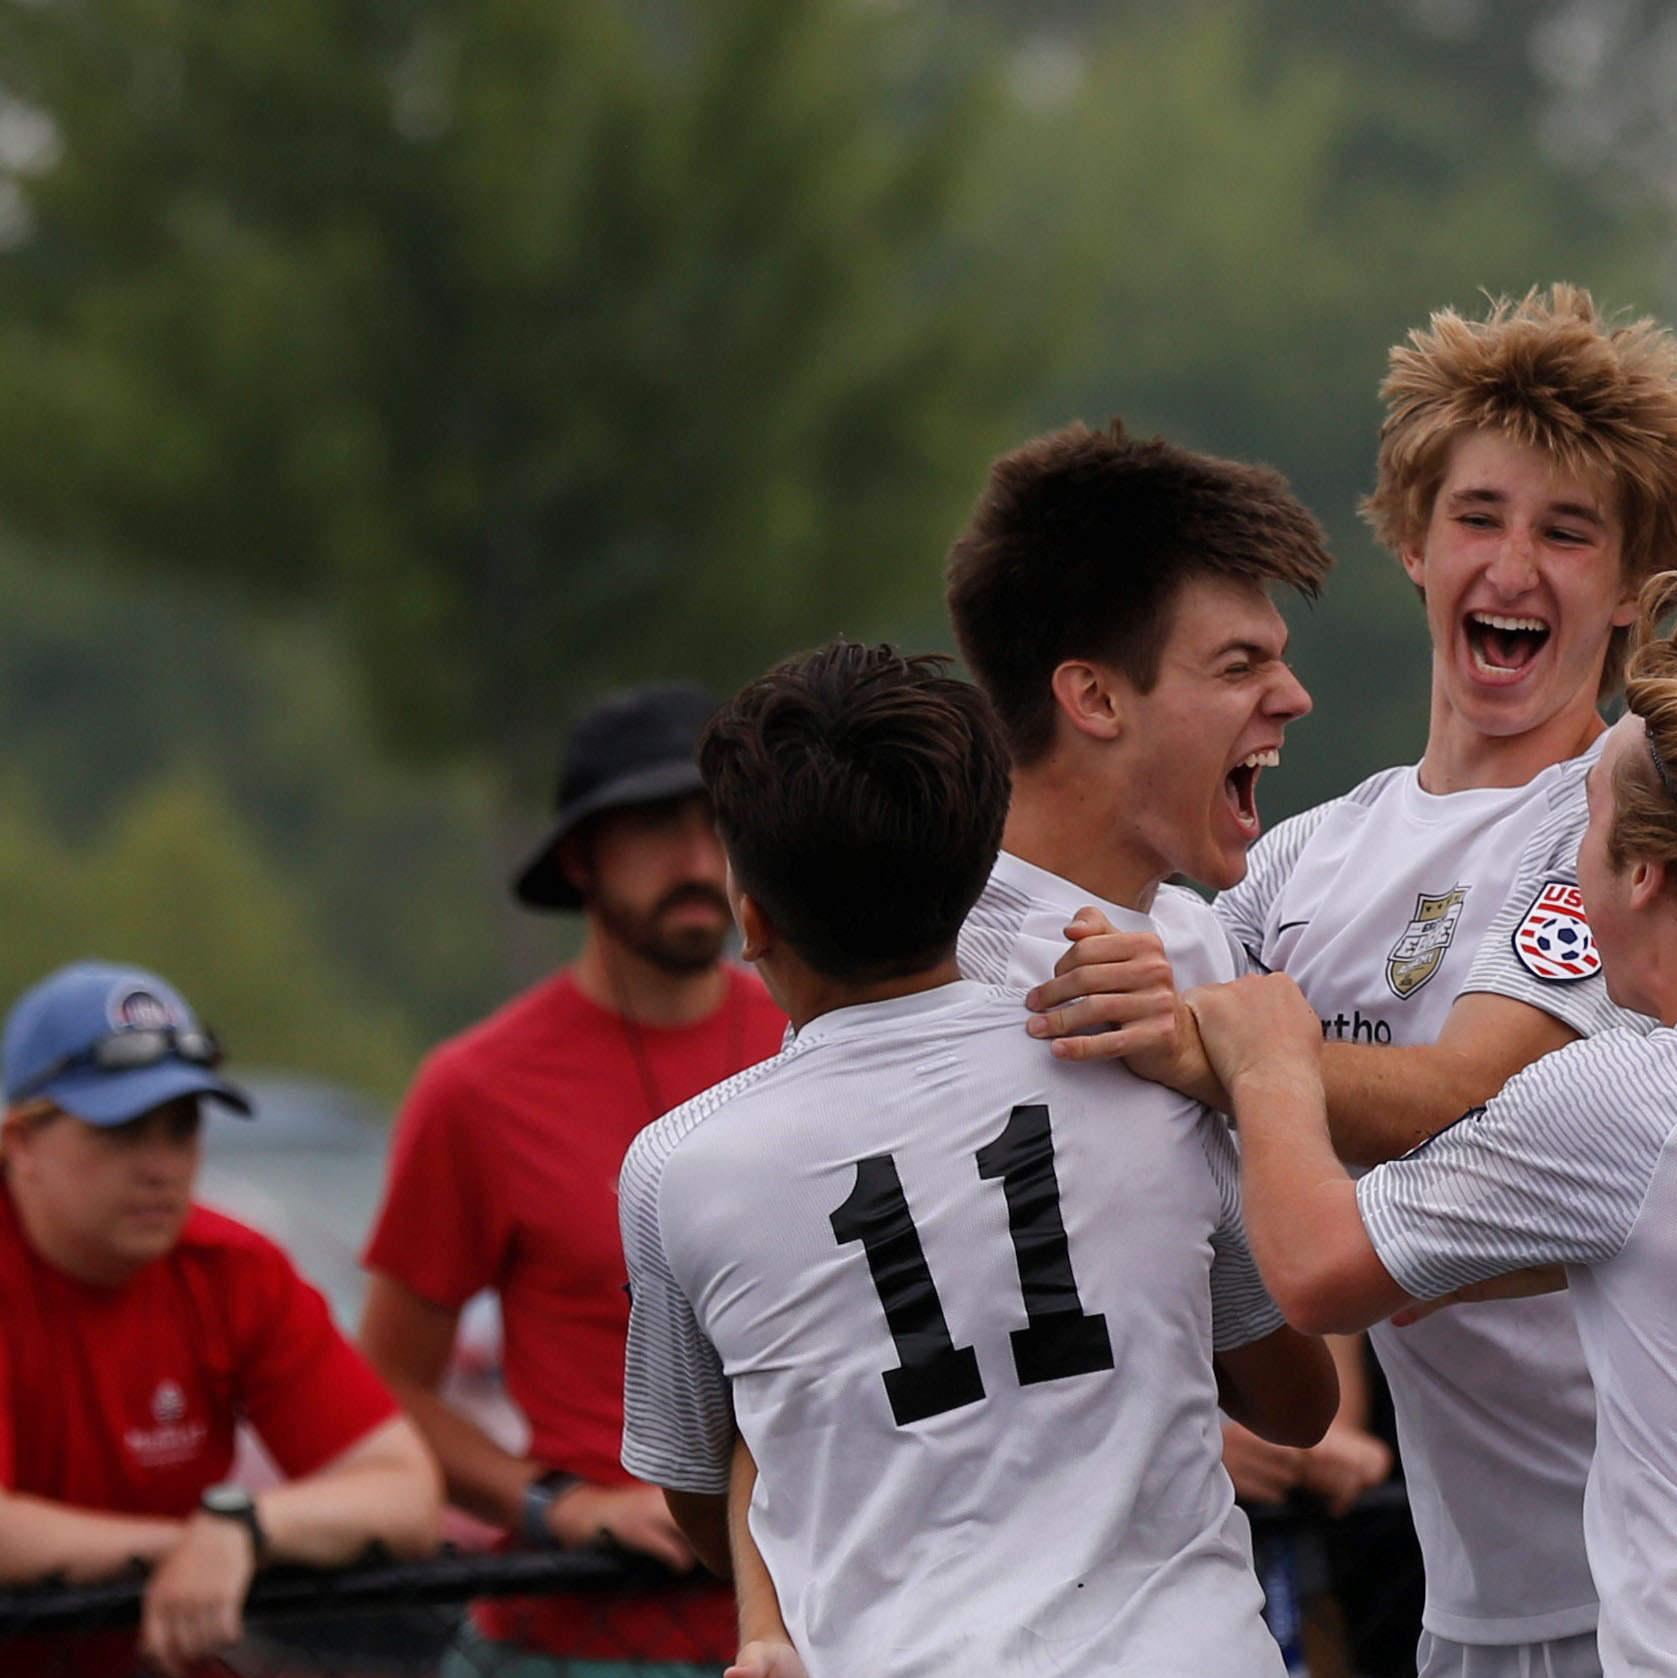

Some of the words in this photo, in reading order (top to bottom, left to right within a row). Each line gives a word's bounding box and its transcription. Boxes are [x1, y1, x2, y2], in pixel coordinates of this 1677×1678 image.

[1544, 886, 1582, 908] US
[1321, 1010, 1392, 1045] rtho
[829, 1104, 1114, 1426] 11
